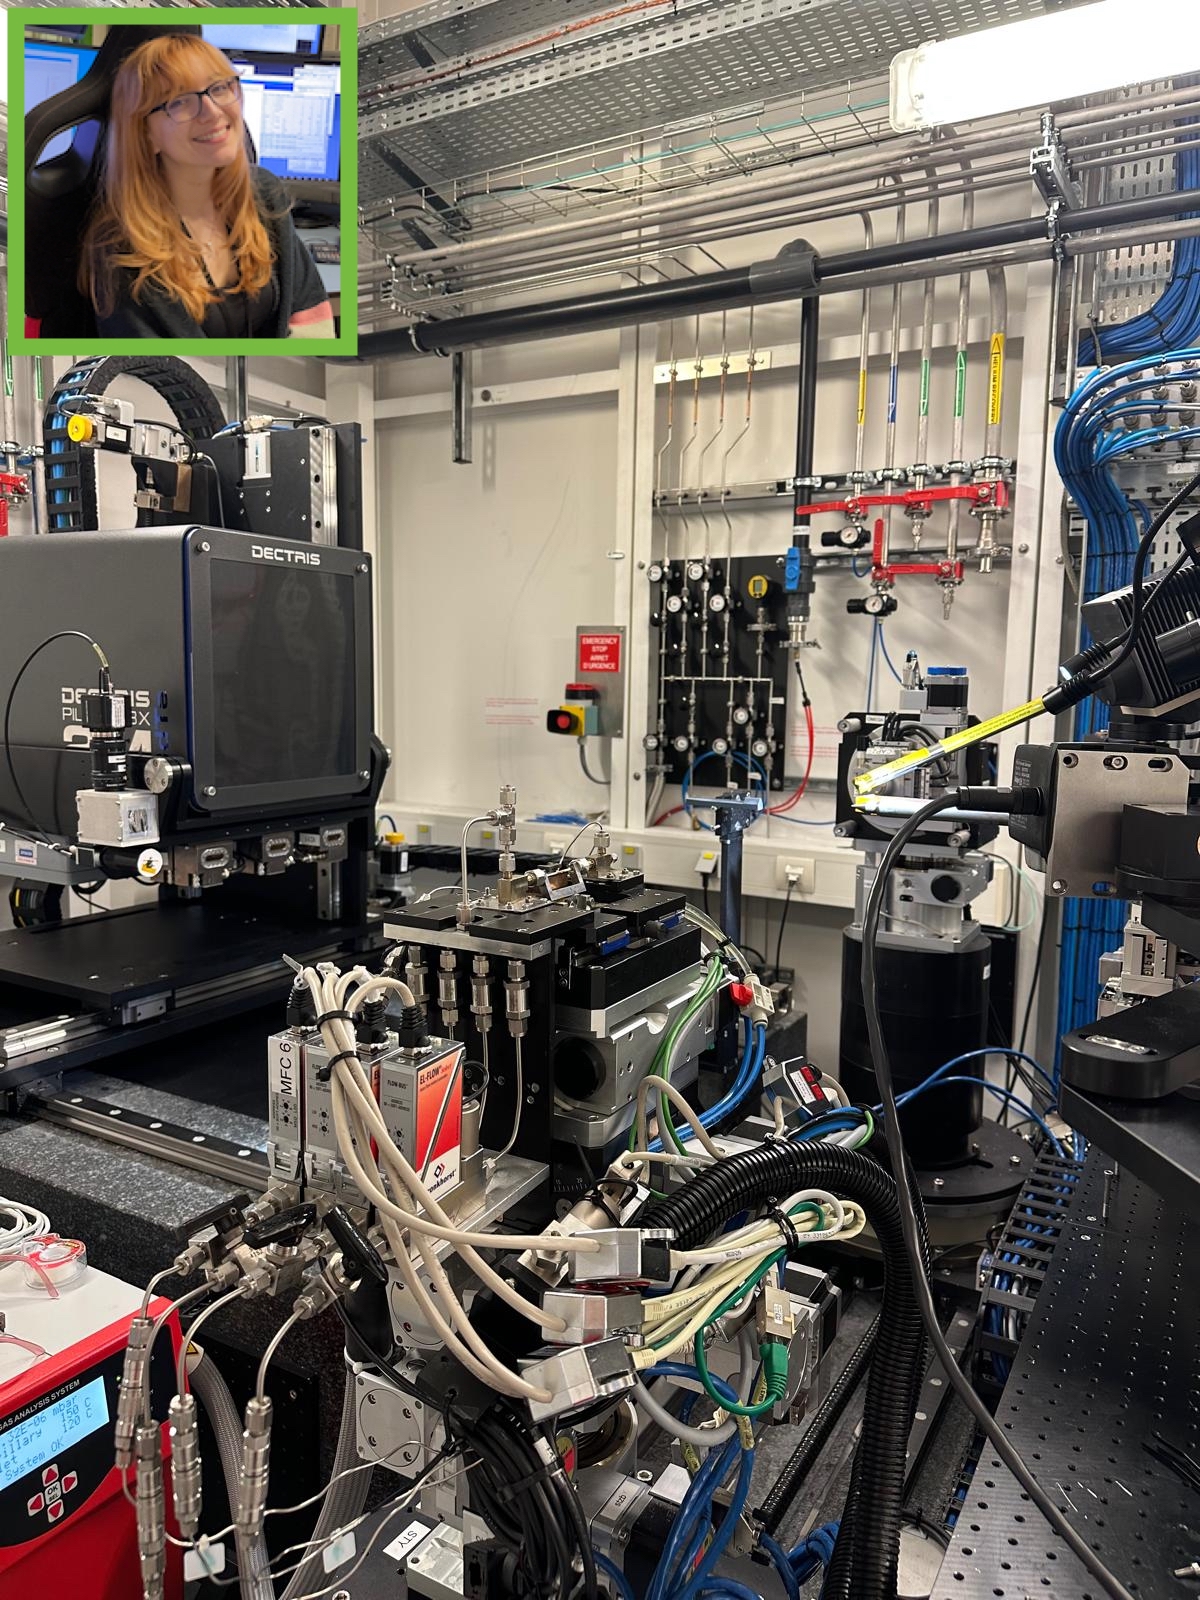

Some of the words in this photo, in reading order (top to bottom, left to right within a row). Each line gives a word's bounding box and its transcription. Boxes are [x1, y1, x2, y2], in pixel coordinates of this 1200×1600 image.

[251, 545, 321, 566] DECTRIS
[61, 687, 151, 708] DEIS
[280, 1043, 291, 1052] 6
[280, 1057, 292, 1095] MFC
[14, 1396, 50, 1423] ANALYSIS
[51, 1379, 80, 1401] SYSTEM
[52, 1395, 78, 1417] mbar
[0, 1428, 42, 1458] illary
[61, 1405, 80, 1423] 150
[84, 1396, 91, 1408] C
[63, 1415, 81, 1433] 120
[86, 1407, 92, 1419] C
[5, 1452, 46, 1481] System
[51, 1436, 65, 1453] OK
[47, 1484, 58, 1495] OK
[397, 1530, 418, 1549] STY
